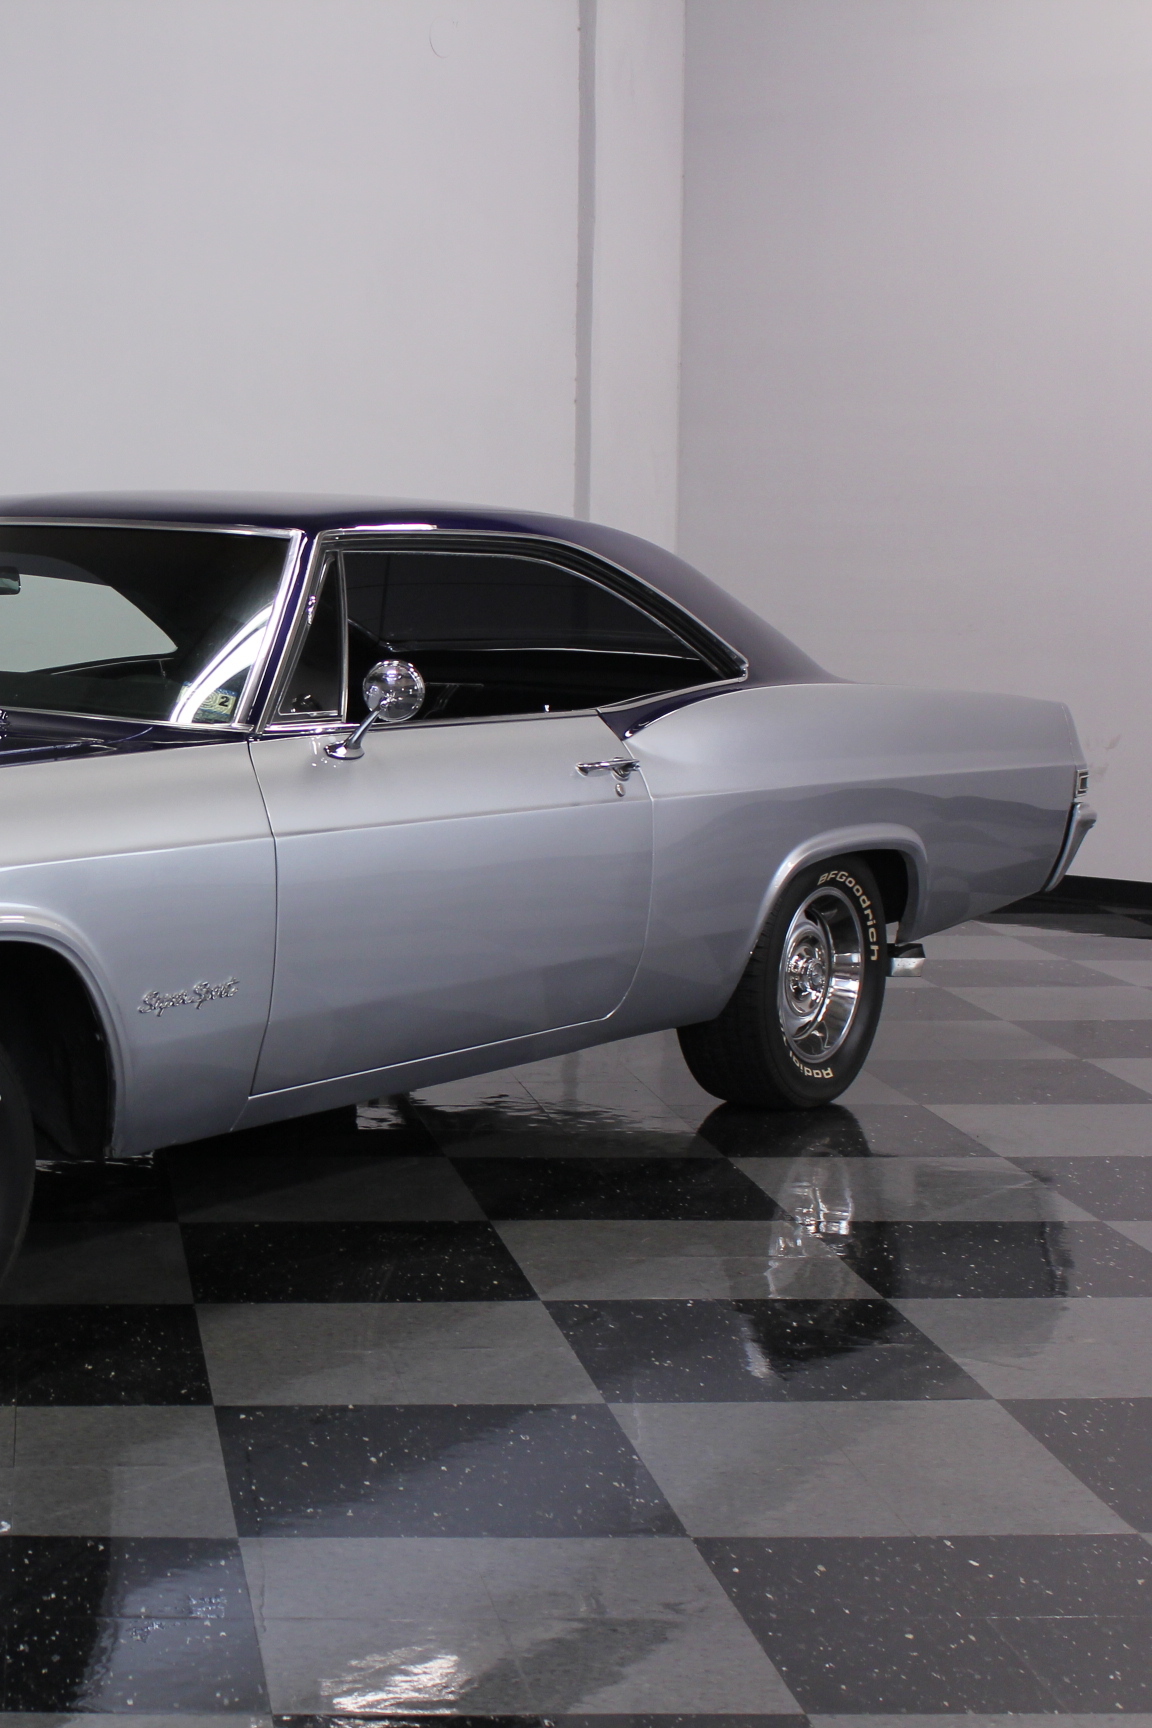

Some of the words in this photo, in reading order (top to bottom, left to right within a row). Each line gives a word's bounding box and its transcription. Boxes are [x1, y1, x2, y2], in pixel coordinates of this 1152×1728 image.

[218, 695, 230, 707] 2
[817, 870, 880, 961] BFGoodrich
[789, 1050, 834, 1079] Radial
